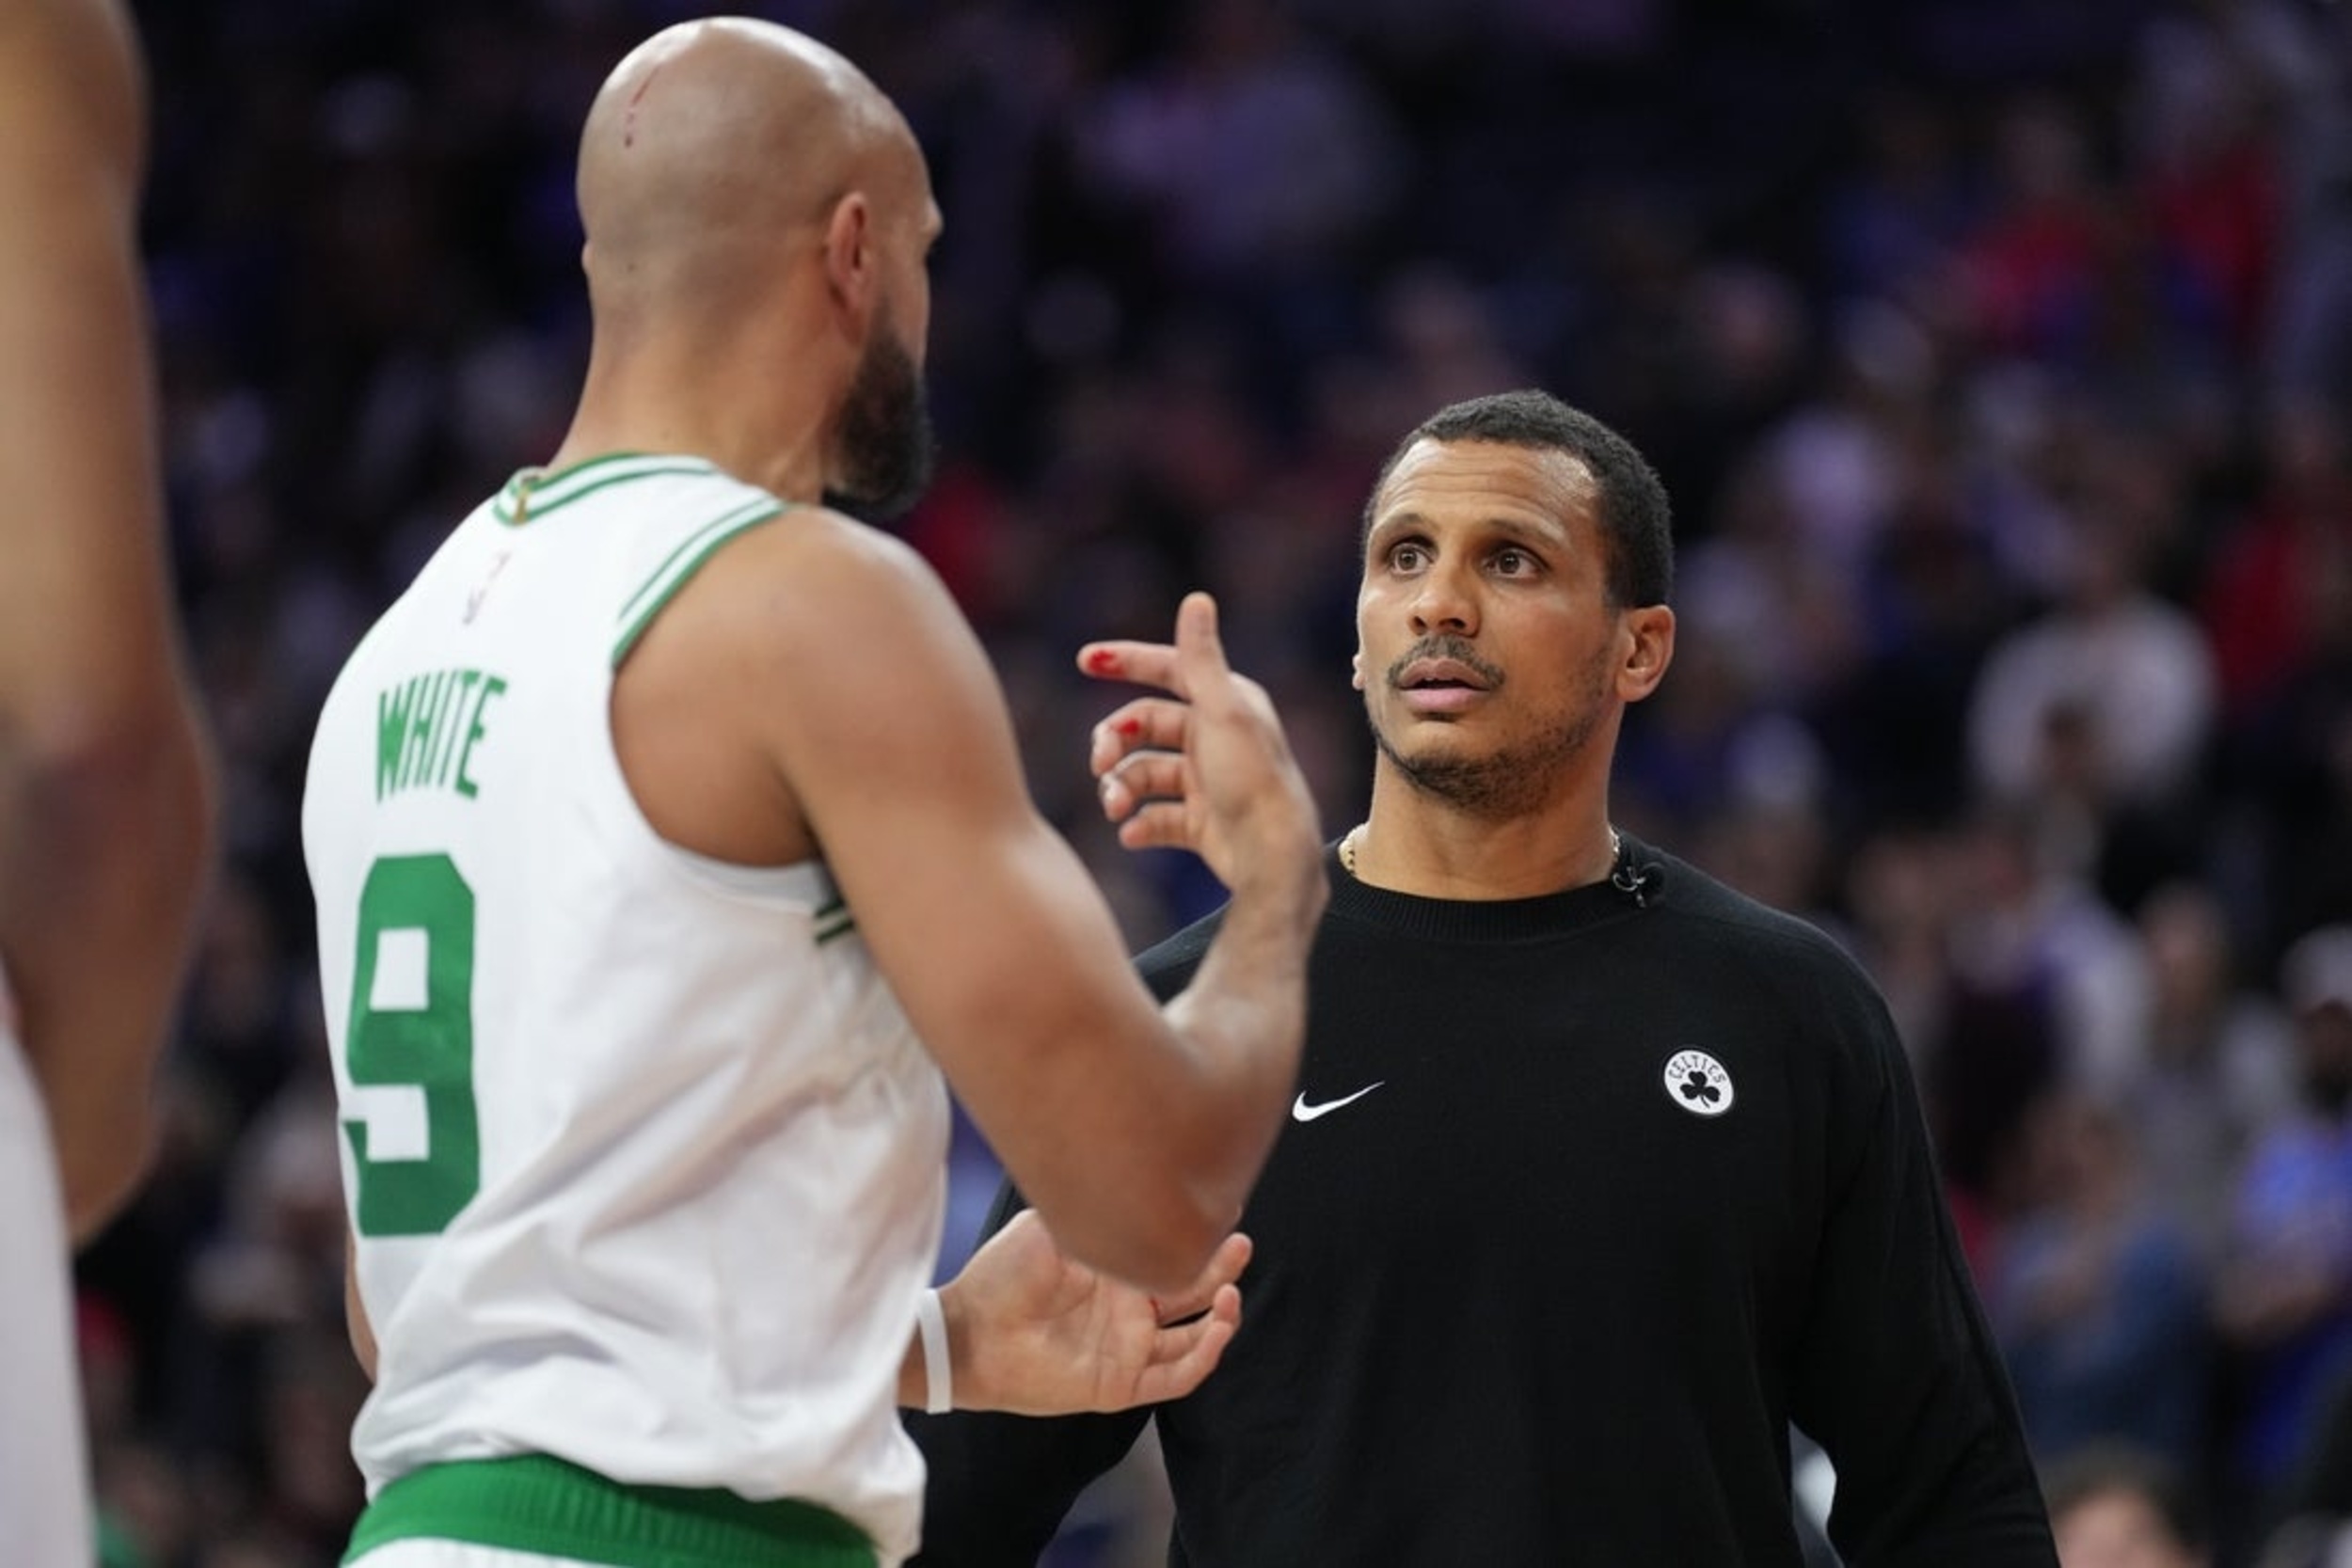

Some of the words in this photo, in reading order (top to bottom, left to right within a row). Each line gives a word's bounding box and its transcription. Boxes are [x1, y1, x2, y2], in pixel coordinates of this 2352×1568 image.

[377, 669, 508, 802] WHITE
[342, 852, 480, 1237] 9
[1668, 1053, 1727, 1084] CELTICS
